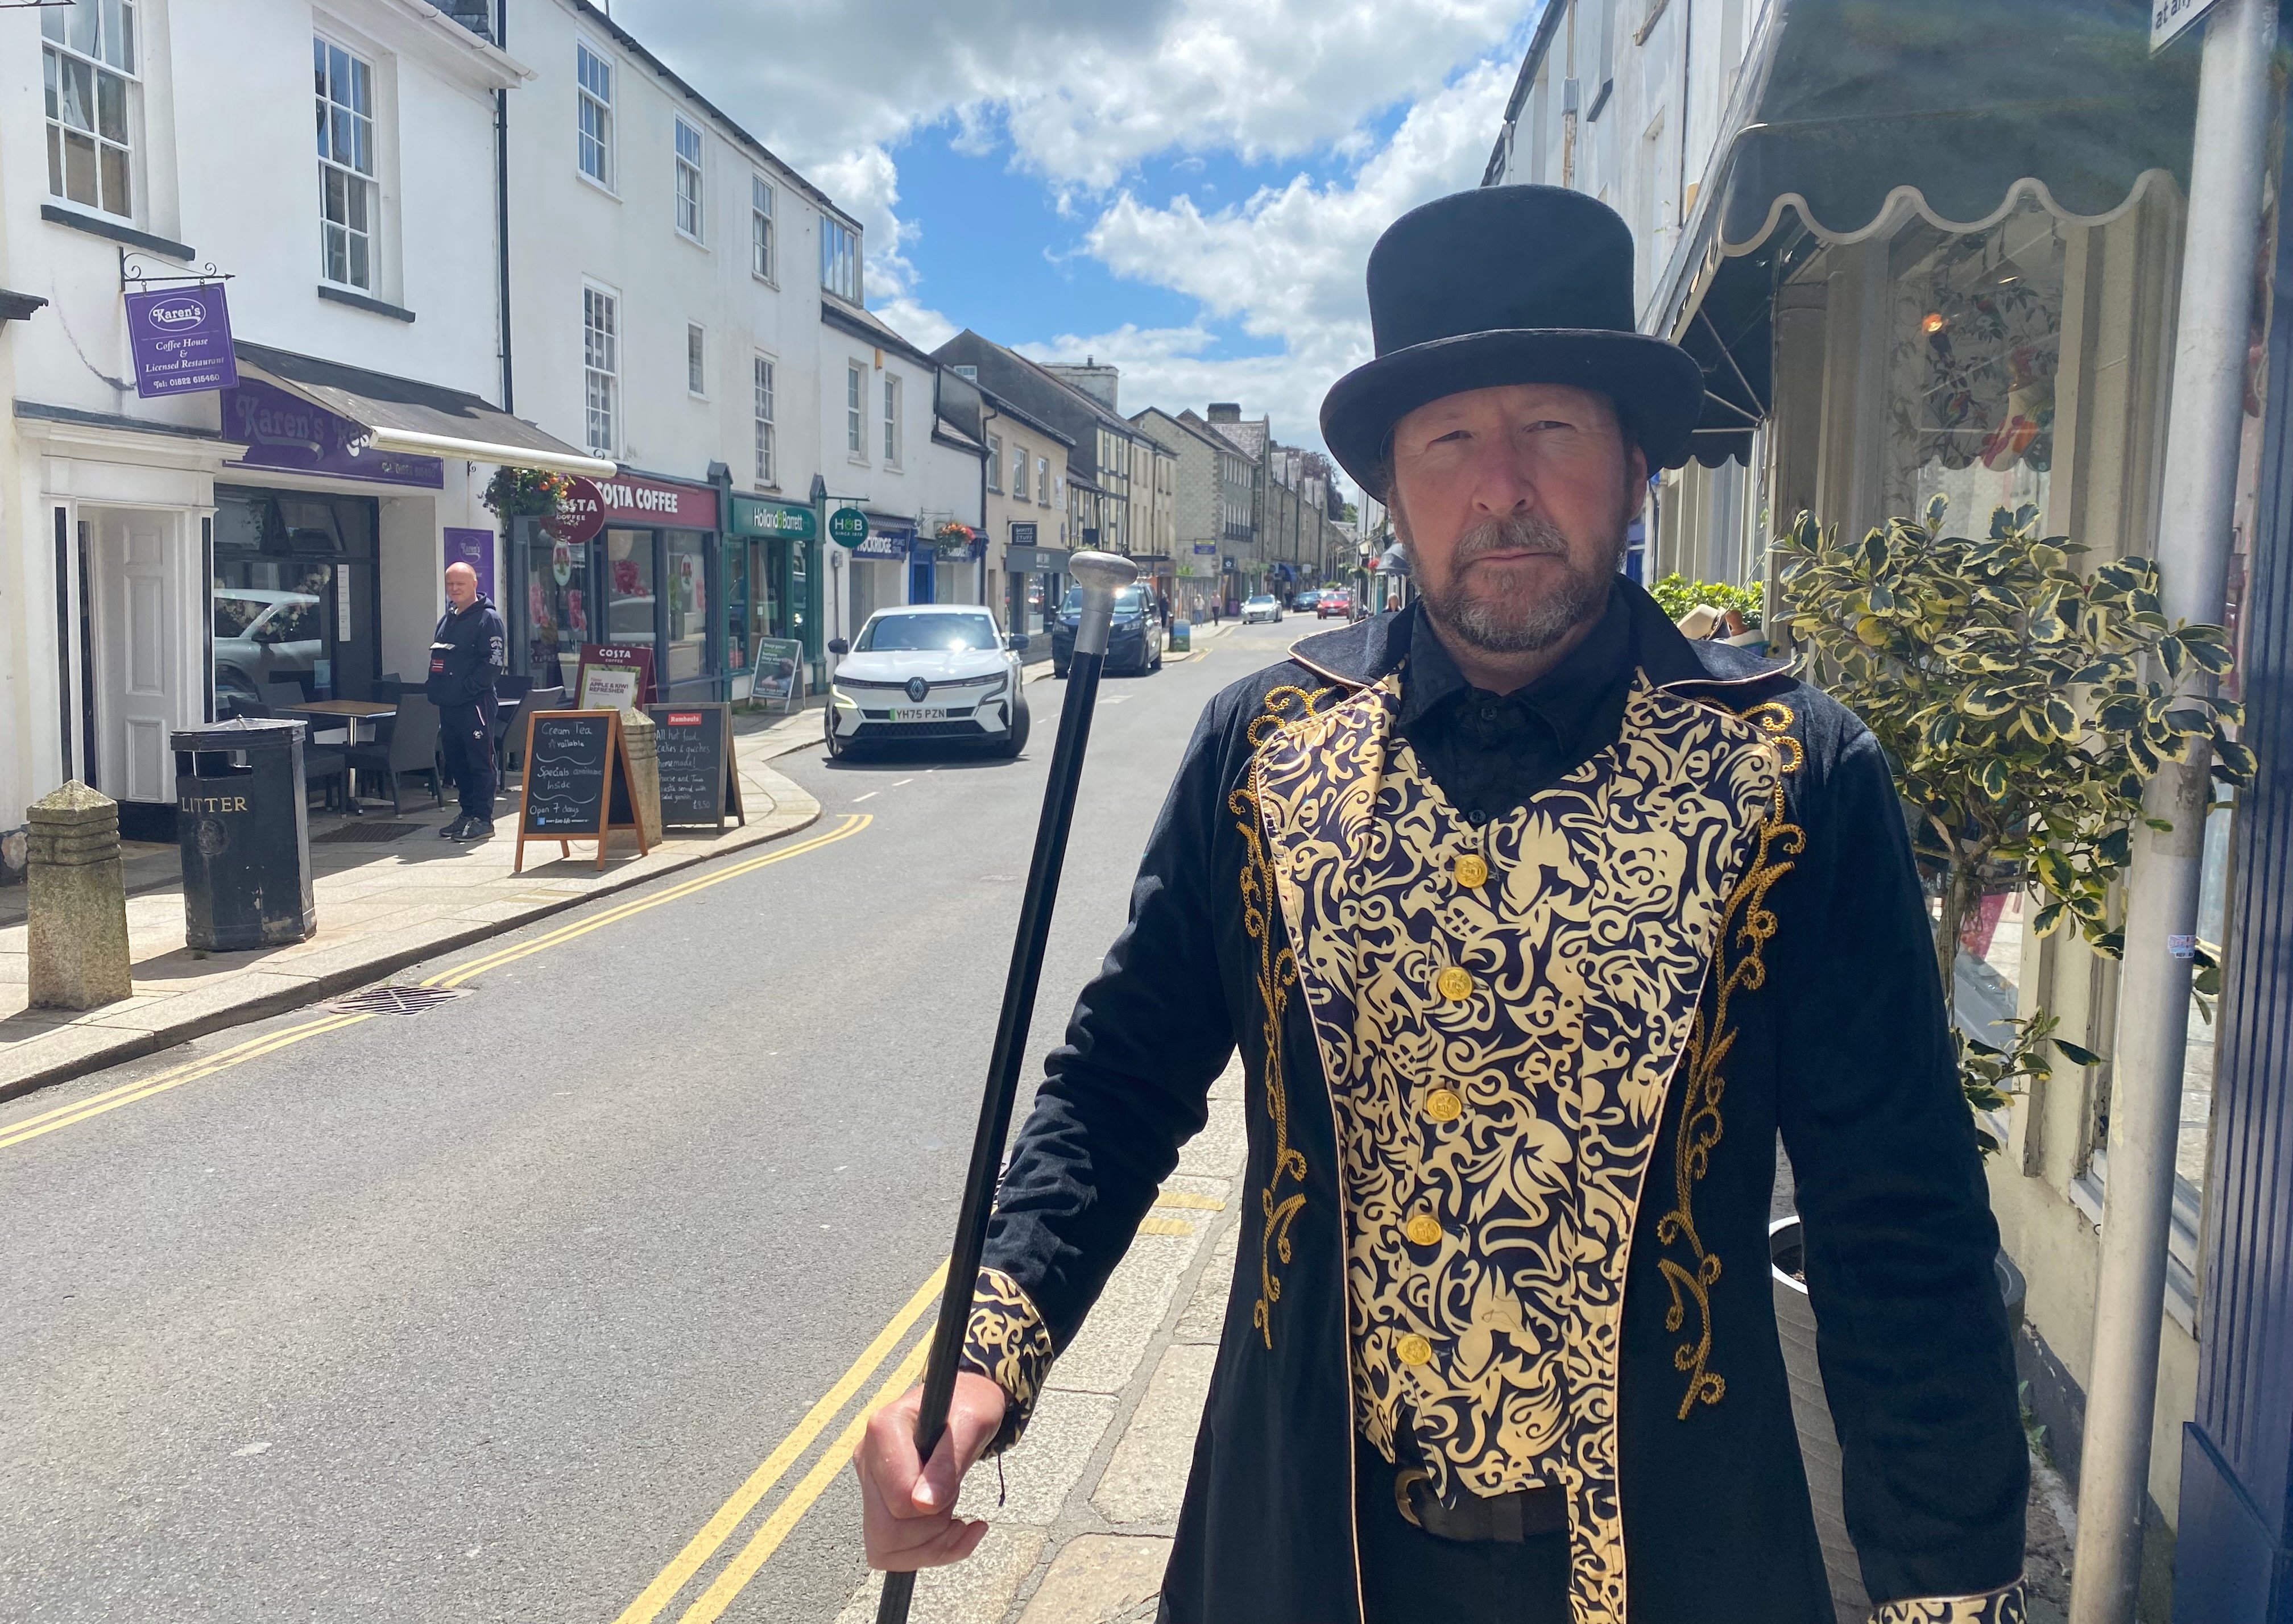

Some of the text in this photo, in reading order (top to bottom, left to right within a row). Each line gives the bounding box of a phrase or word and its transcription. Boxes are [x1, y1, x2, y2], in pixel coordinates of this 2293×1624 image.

[2155, 1, 2168, 30] at
[152, 305, 201, 322] Karen's
[156, 338, 208, 351] Coffee House
[146, 357, 224, 372] Licensed Restaurant
[170, 377, 191, 386] 01822
[193, 374, 220, 383] 615460
[235, 394, 325, 461] Karen's
[635, 488, 678, 513] COFFEE
[754, 507, 778, 528] Holland
[783, 511, 802, 531] Barrett
[599, 649, 631, 658] COSTA
[896, 709, 945, 719] YH75 PZN
[541, 722, 592, 735] Cream Tea
[656, 729, 665, 740] All
[668, 728, 680, 740] hot
[548, 739, 585, 749] Available
[657, 742, 676, 753] cakes
[686, 743, 710, 757] quiches
[537, 766, 569, 779] Specials
[659, 773, 675, 782] heese
[547, 780, 570, 790] Inside
[660, 784, 676, 793] oastie
[182, 797, 247, 812] LITTER
[529, 802, 579, 817] Open 7 days
